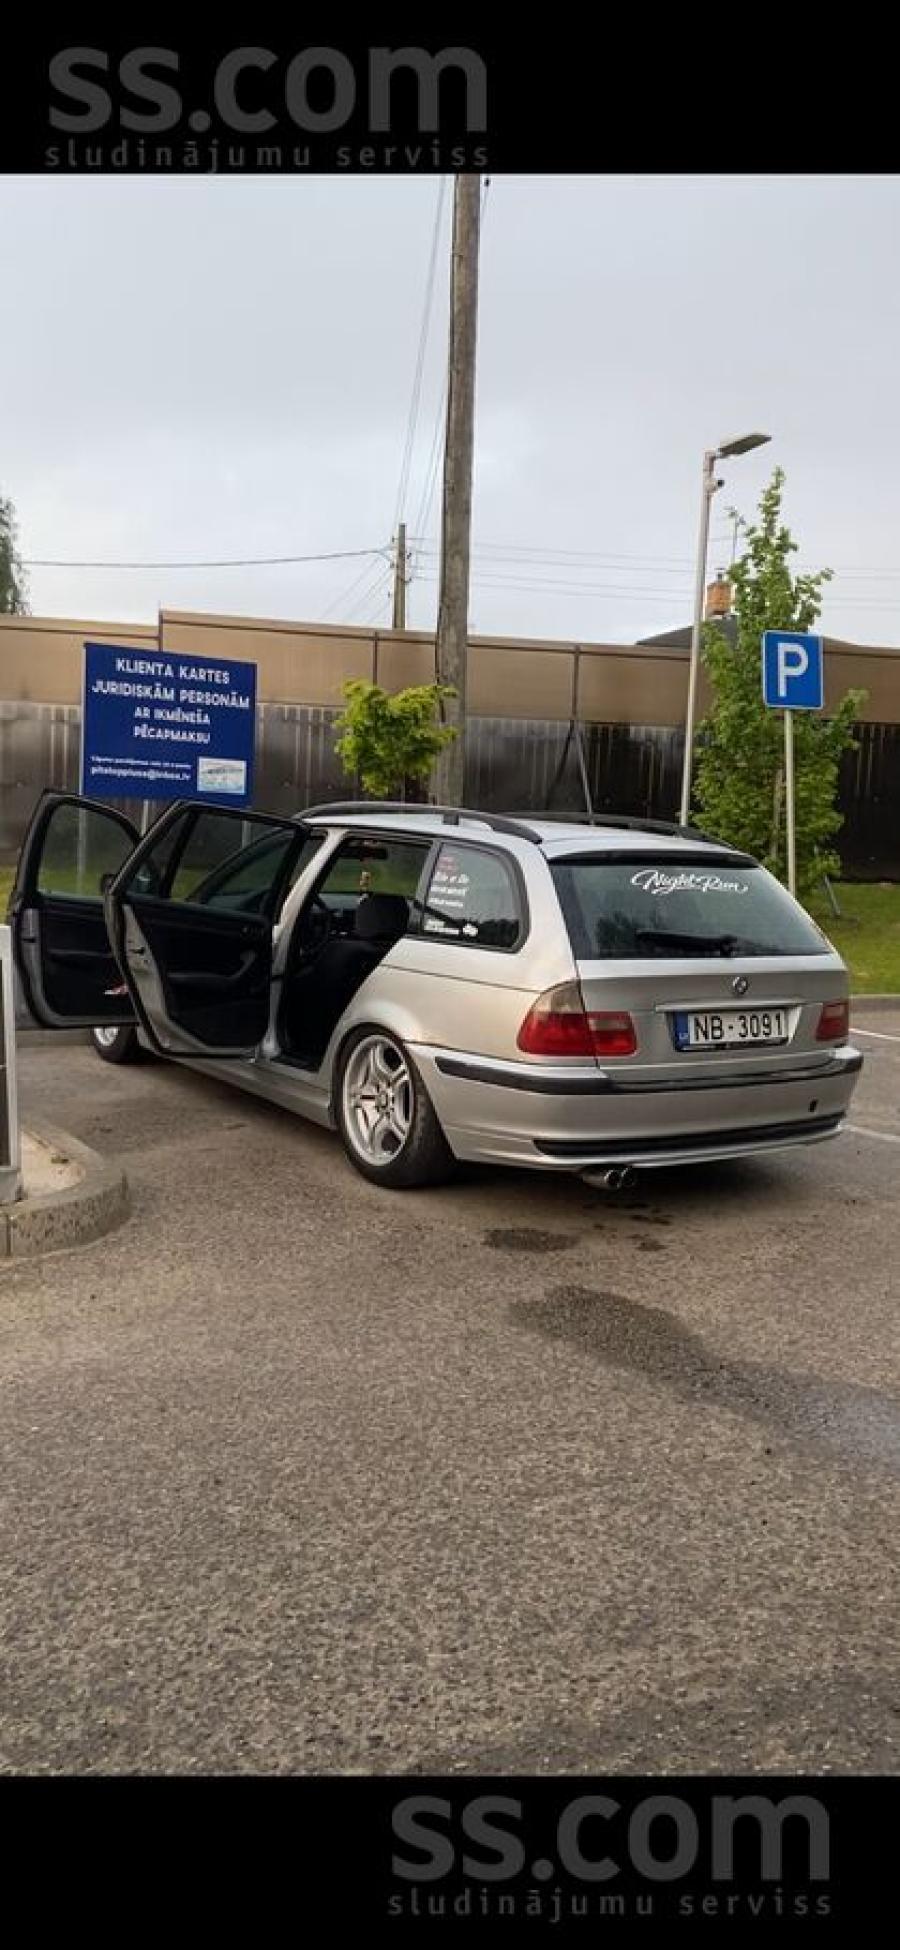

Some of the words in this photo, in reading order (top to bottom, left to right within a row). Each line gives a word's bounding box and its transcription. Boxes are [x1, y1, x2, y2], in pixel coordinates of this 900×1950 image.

[115, 658, 174, 678] KLIENTA
[179, 665, 230, 685] KARTES
[778, 643, 808, 697] P
[91, 680, 175, 702] JURIDISKĀM
[179, 689, 250, 709] PERSONĀM
[134, 706, 151, 719] AR
[133, 724, 211, 744] PĒCAPMAKSU
[631, 869, 698, 894] Night
[695, 875, 749, 894] Run
